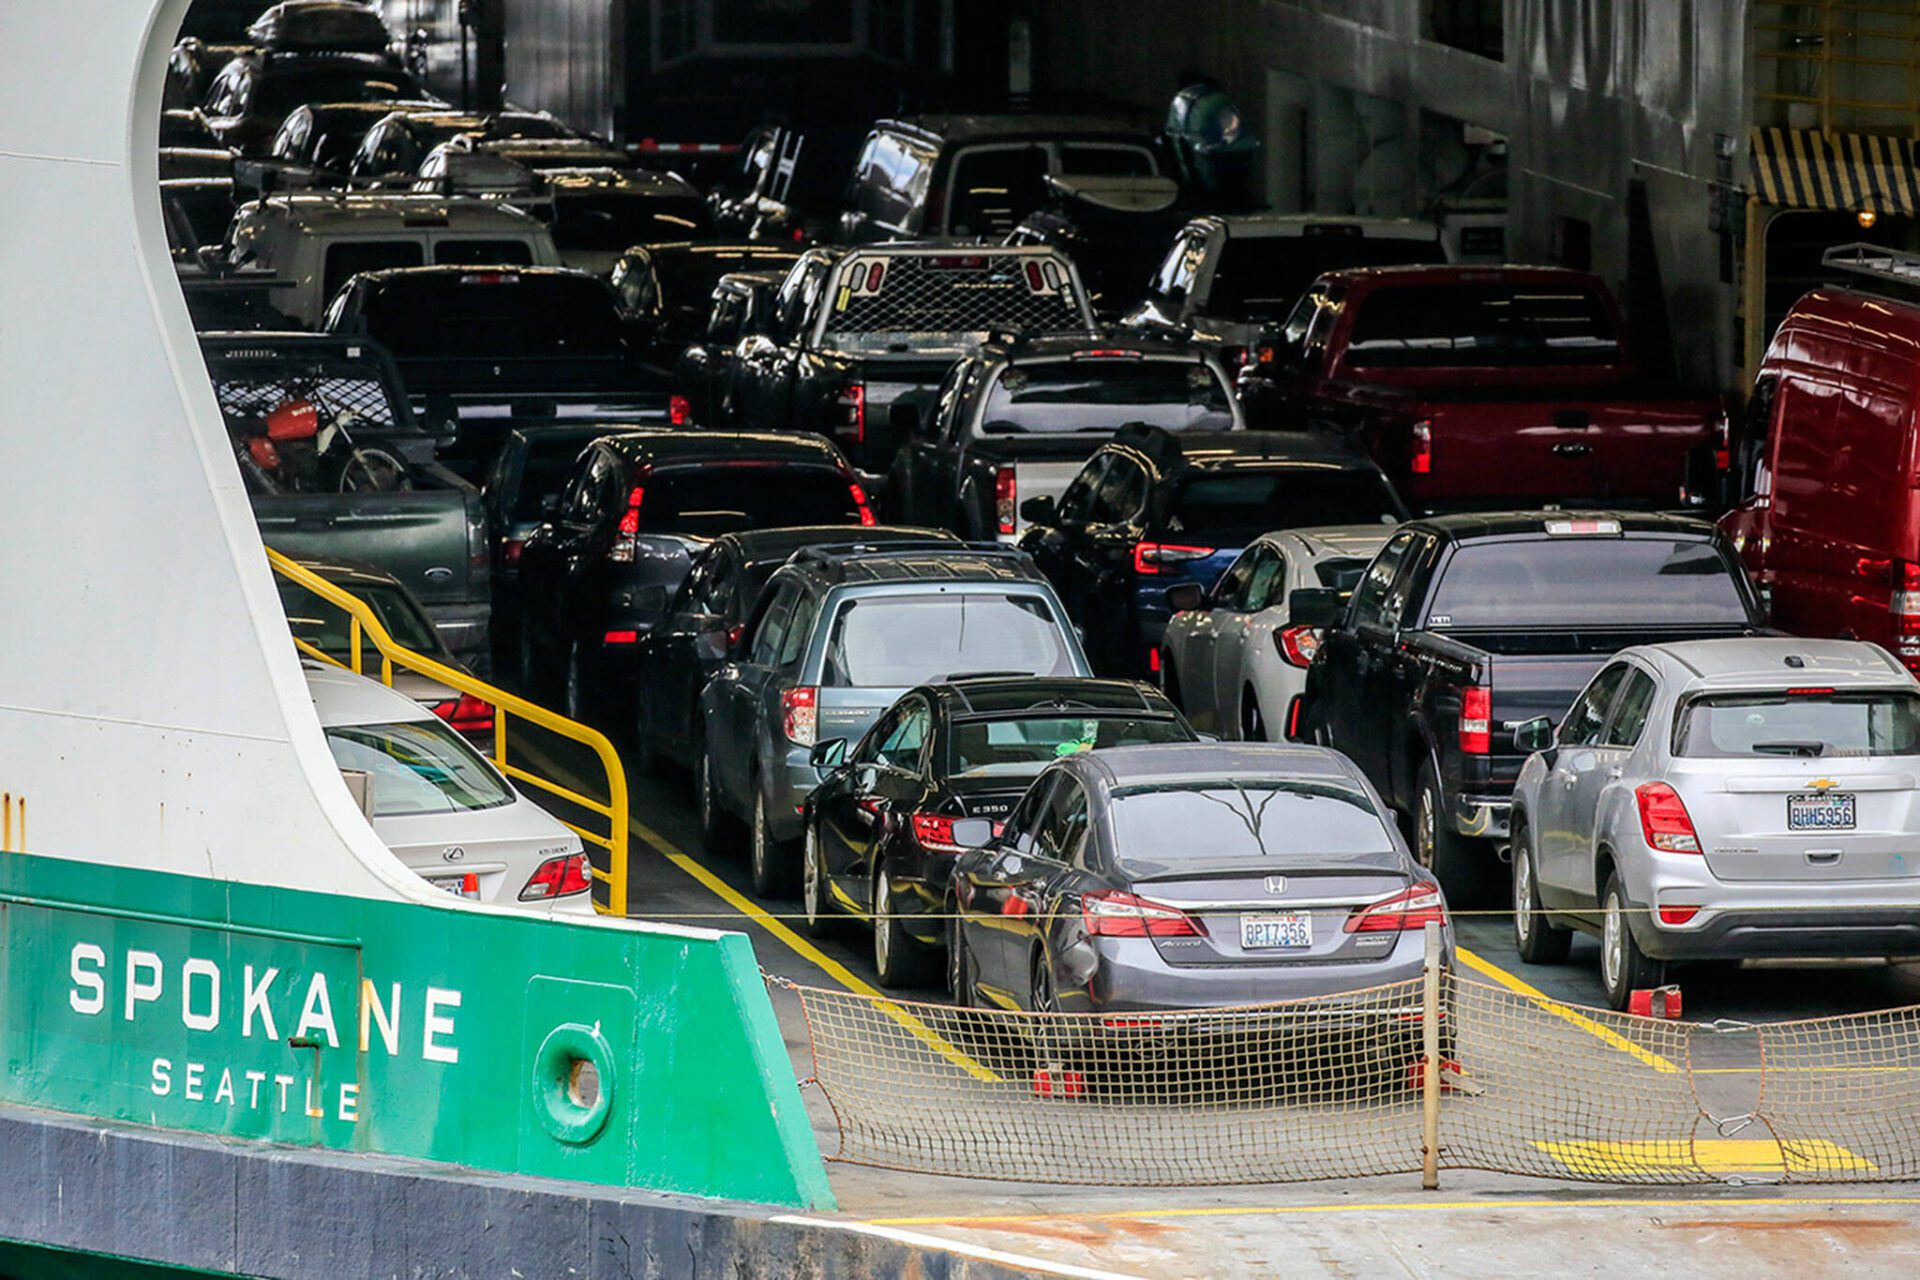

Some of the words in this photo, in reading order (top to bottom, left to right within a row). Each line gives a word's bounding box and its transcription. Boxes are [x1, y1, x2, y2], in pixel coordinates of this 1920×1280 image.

[1246, 923, 1306, 941] BPT7356
[69, 942, 463, 1063] SPOKANE
[150, 1057, 361, 1122] SEATTLE
